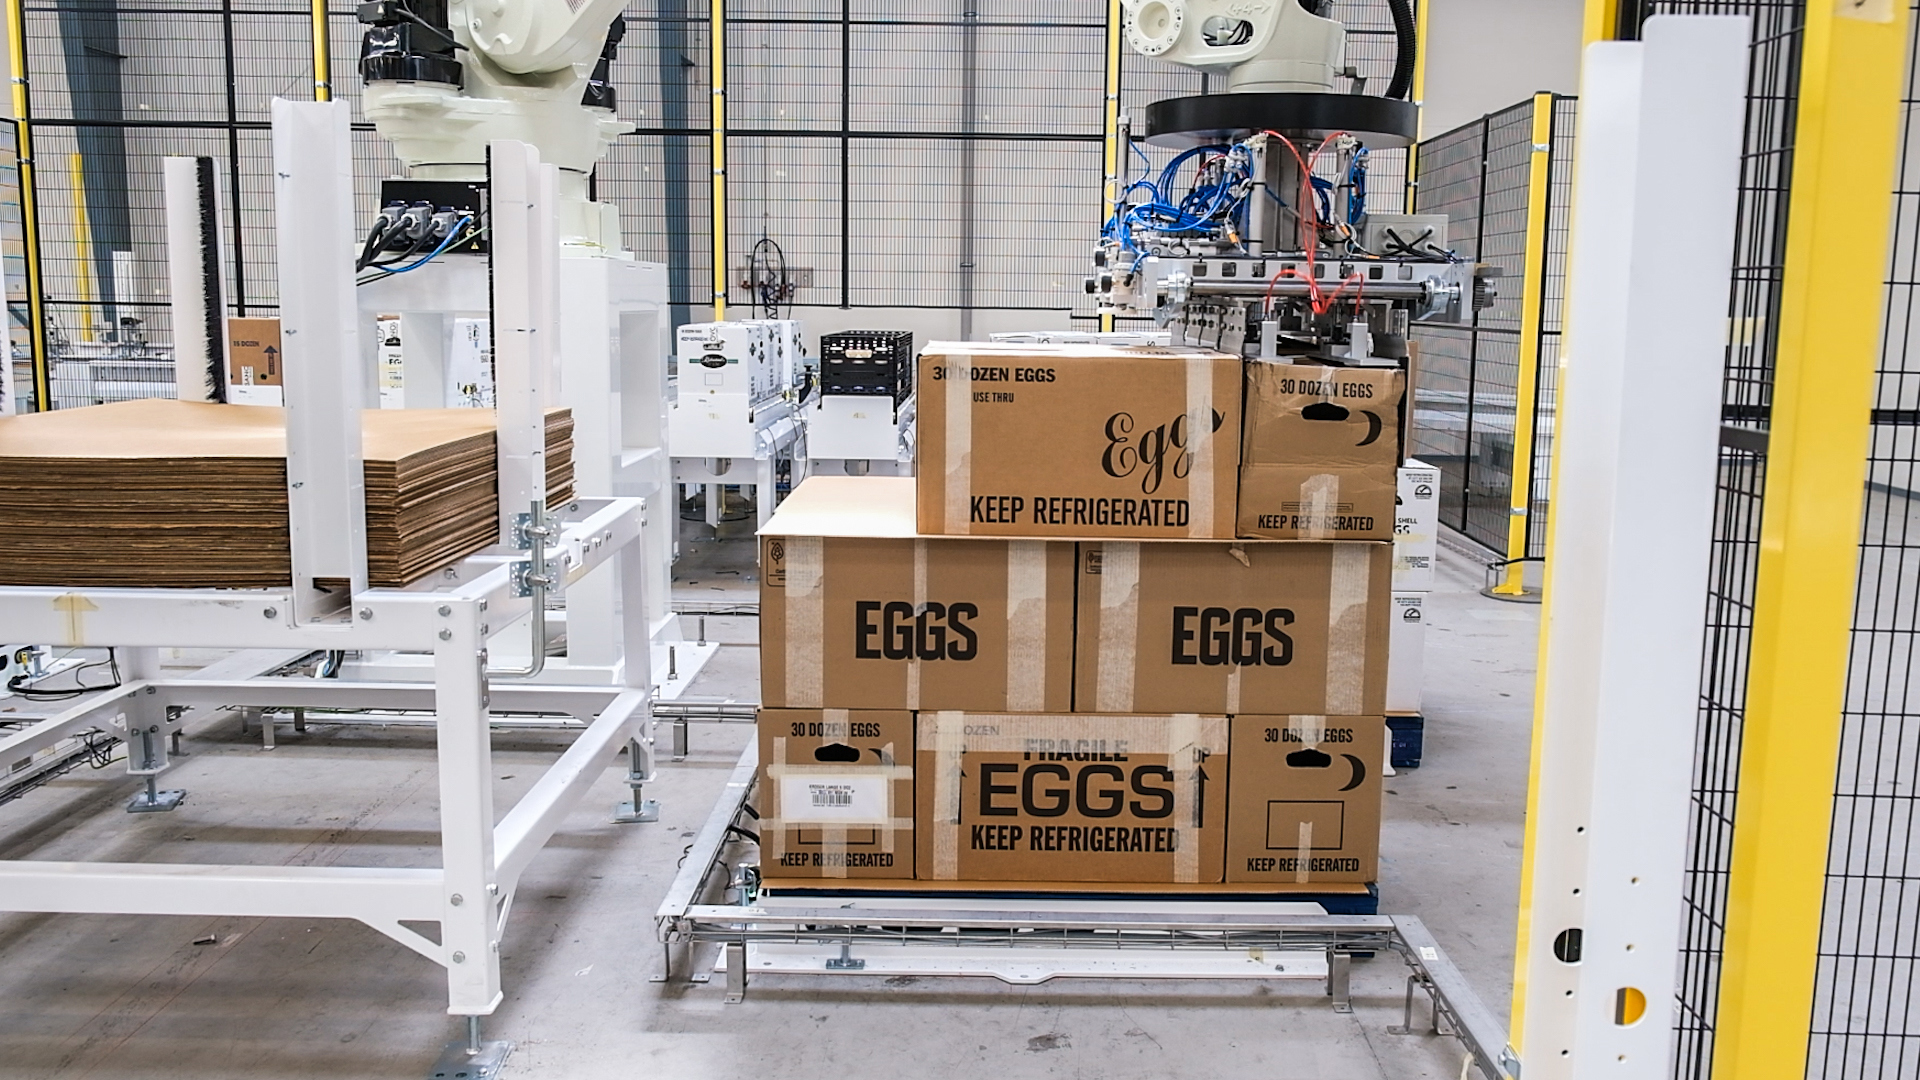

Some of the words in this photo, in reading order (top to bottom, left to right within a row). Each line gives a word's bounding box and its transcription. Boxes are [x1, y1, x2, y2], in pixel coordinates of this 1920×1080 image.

[958, 367, 1009, 382] OZEN
[1015, 367, 1056, 383] EGGS
[1280, 378, 1295, 395] 30
[1342, 382, 1373, 399] EGGS
[973, 392, 990, 403] USE
[992, 392, 1015, 403] THRU
[970, 495, 1024, 524] KEEP
[1033, 496, 1190, 527] REFRIGERATED
[1258, 514, 1288, 529] KEEP
[1291, 515, 1374, 531] REFRIGERATED
[855, 600, 978, 662] EGGS
[1171, 606, 1295, 666] EGGS
[791, 722, 806, 737] 30
[808, 722, 847, 737] DOZEN
[851, 722, 881, 738] EGGS
[959, 725, 1000, 736] OZEN
[1264, 728, 1279, 743] 30
[1323, 728, 1353, 743] EGGS
[1023, 738, 1128, 762] FRAGILE
[1192, 746, 1211, 763] UP
[979, 763, 1174, 819] EGGS
[971, 824, 1023, 851] KEEP
[1030, 825, 1180, 852] REFRIGERATED
[780, 852, 809, 867] KEEP
[813, 852, 894, 867] REFRIGERATED
[1246, 857, 1276, 872] KEEP
[1278, 857, 1360, 872] REFRIGERATED
